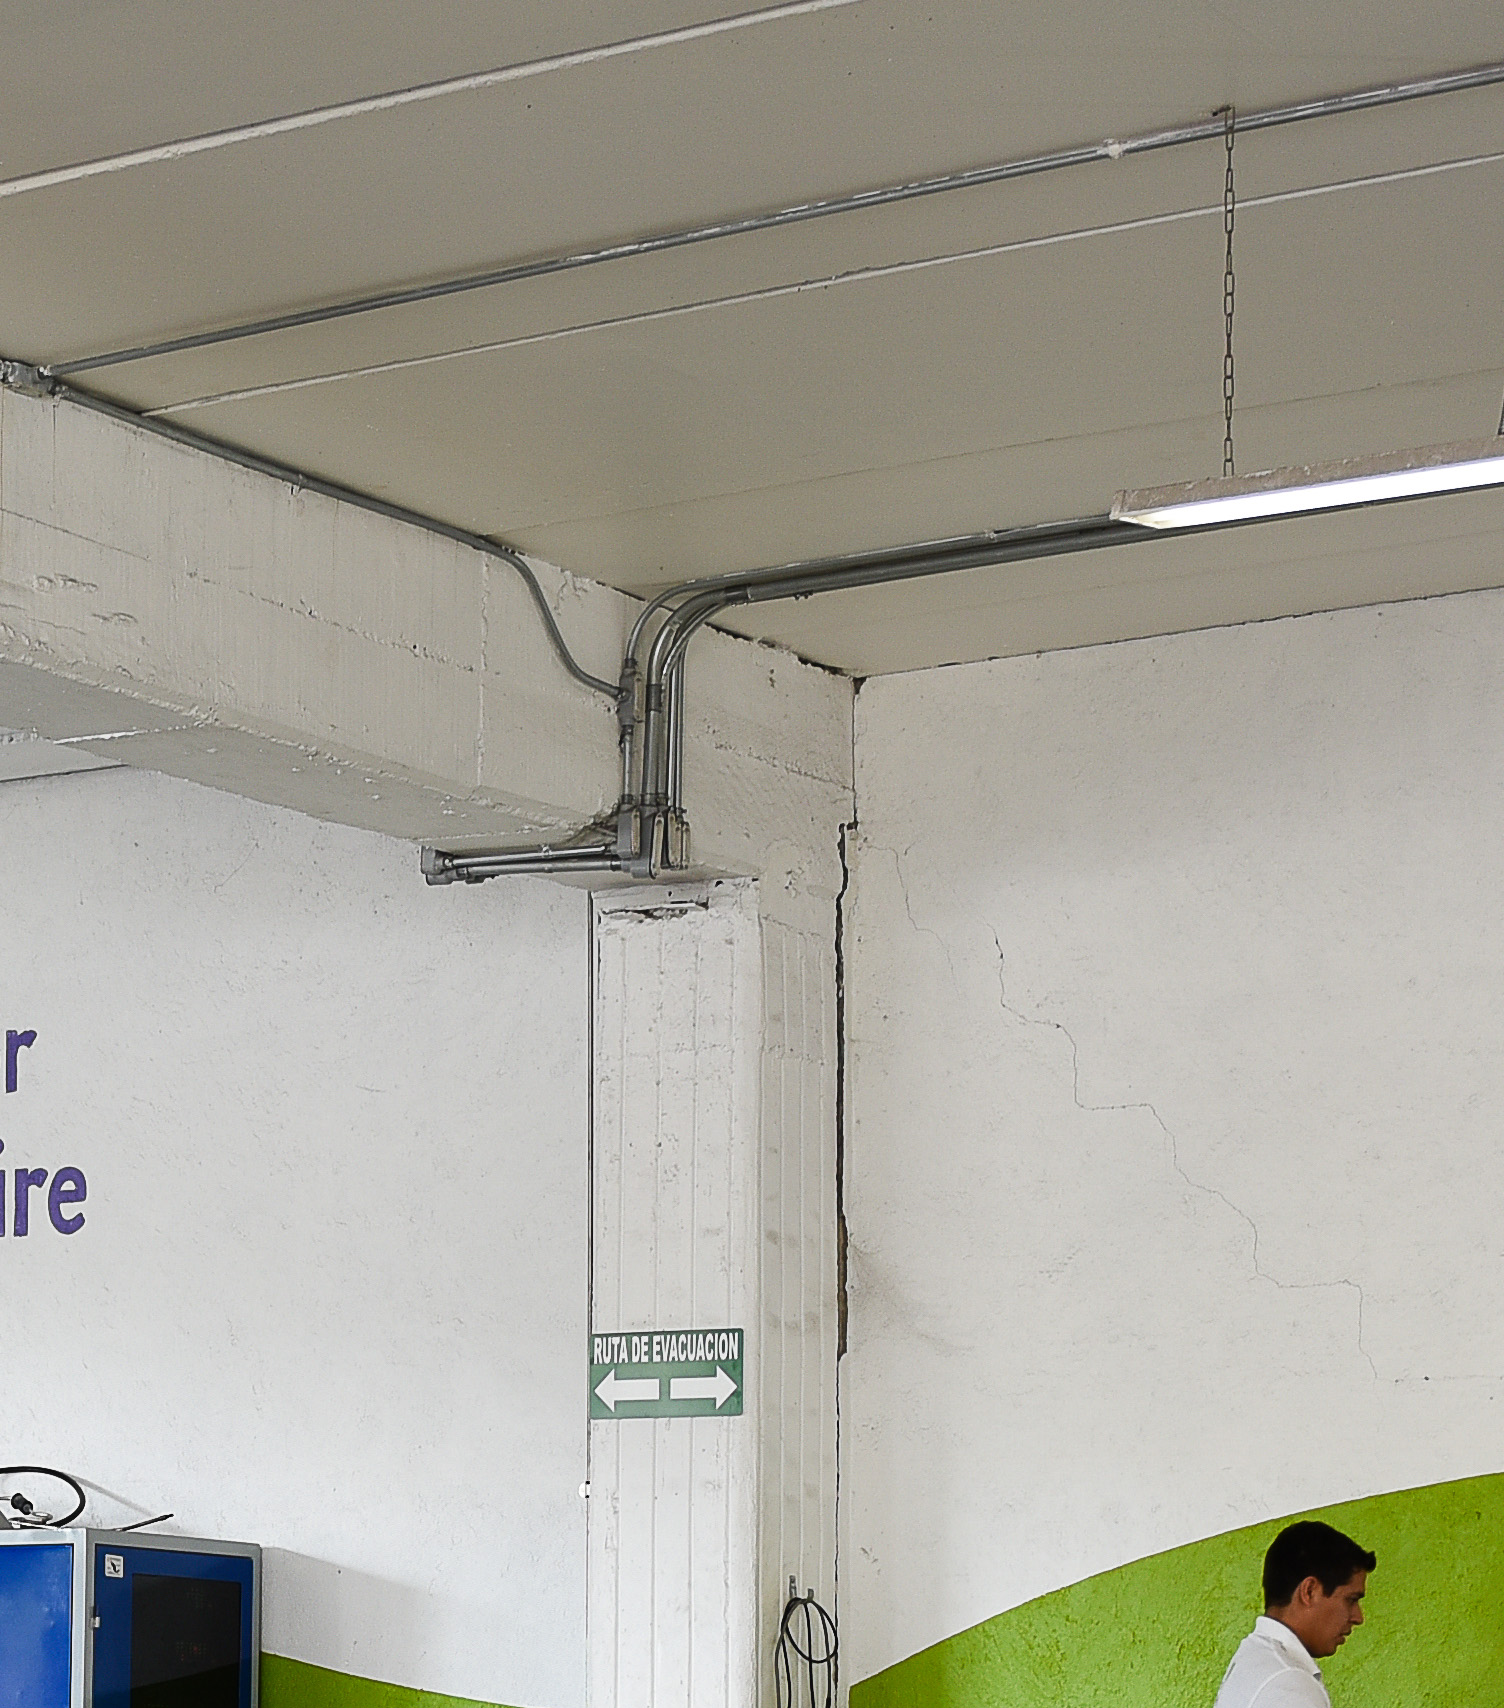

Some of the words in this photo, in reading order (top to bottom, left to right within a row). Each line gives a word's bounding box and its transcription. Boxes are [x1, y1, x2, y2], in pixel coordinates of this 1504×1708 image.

[593, 1336, 629, 1365] RUTA
[631, 1335, 649, 1363] DE
[652, 1332, 739, 1362] EVACUACION
